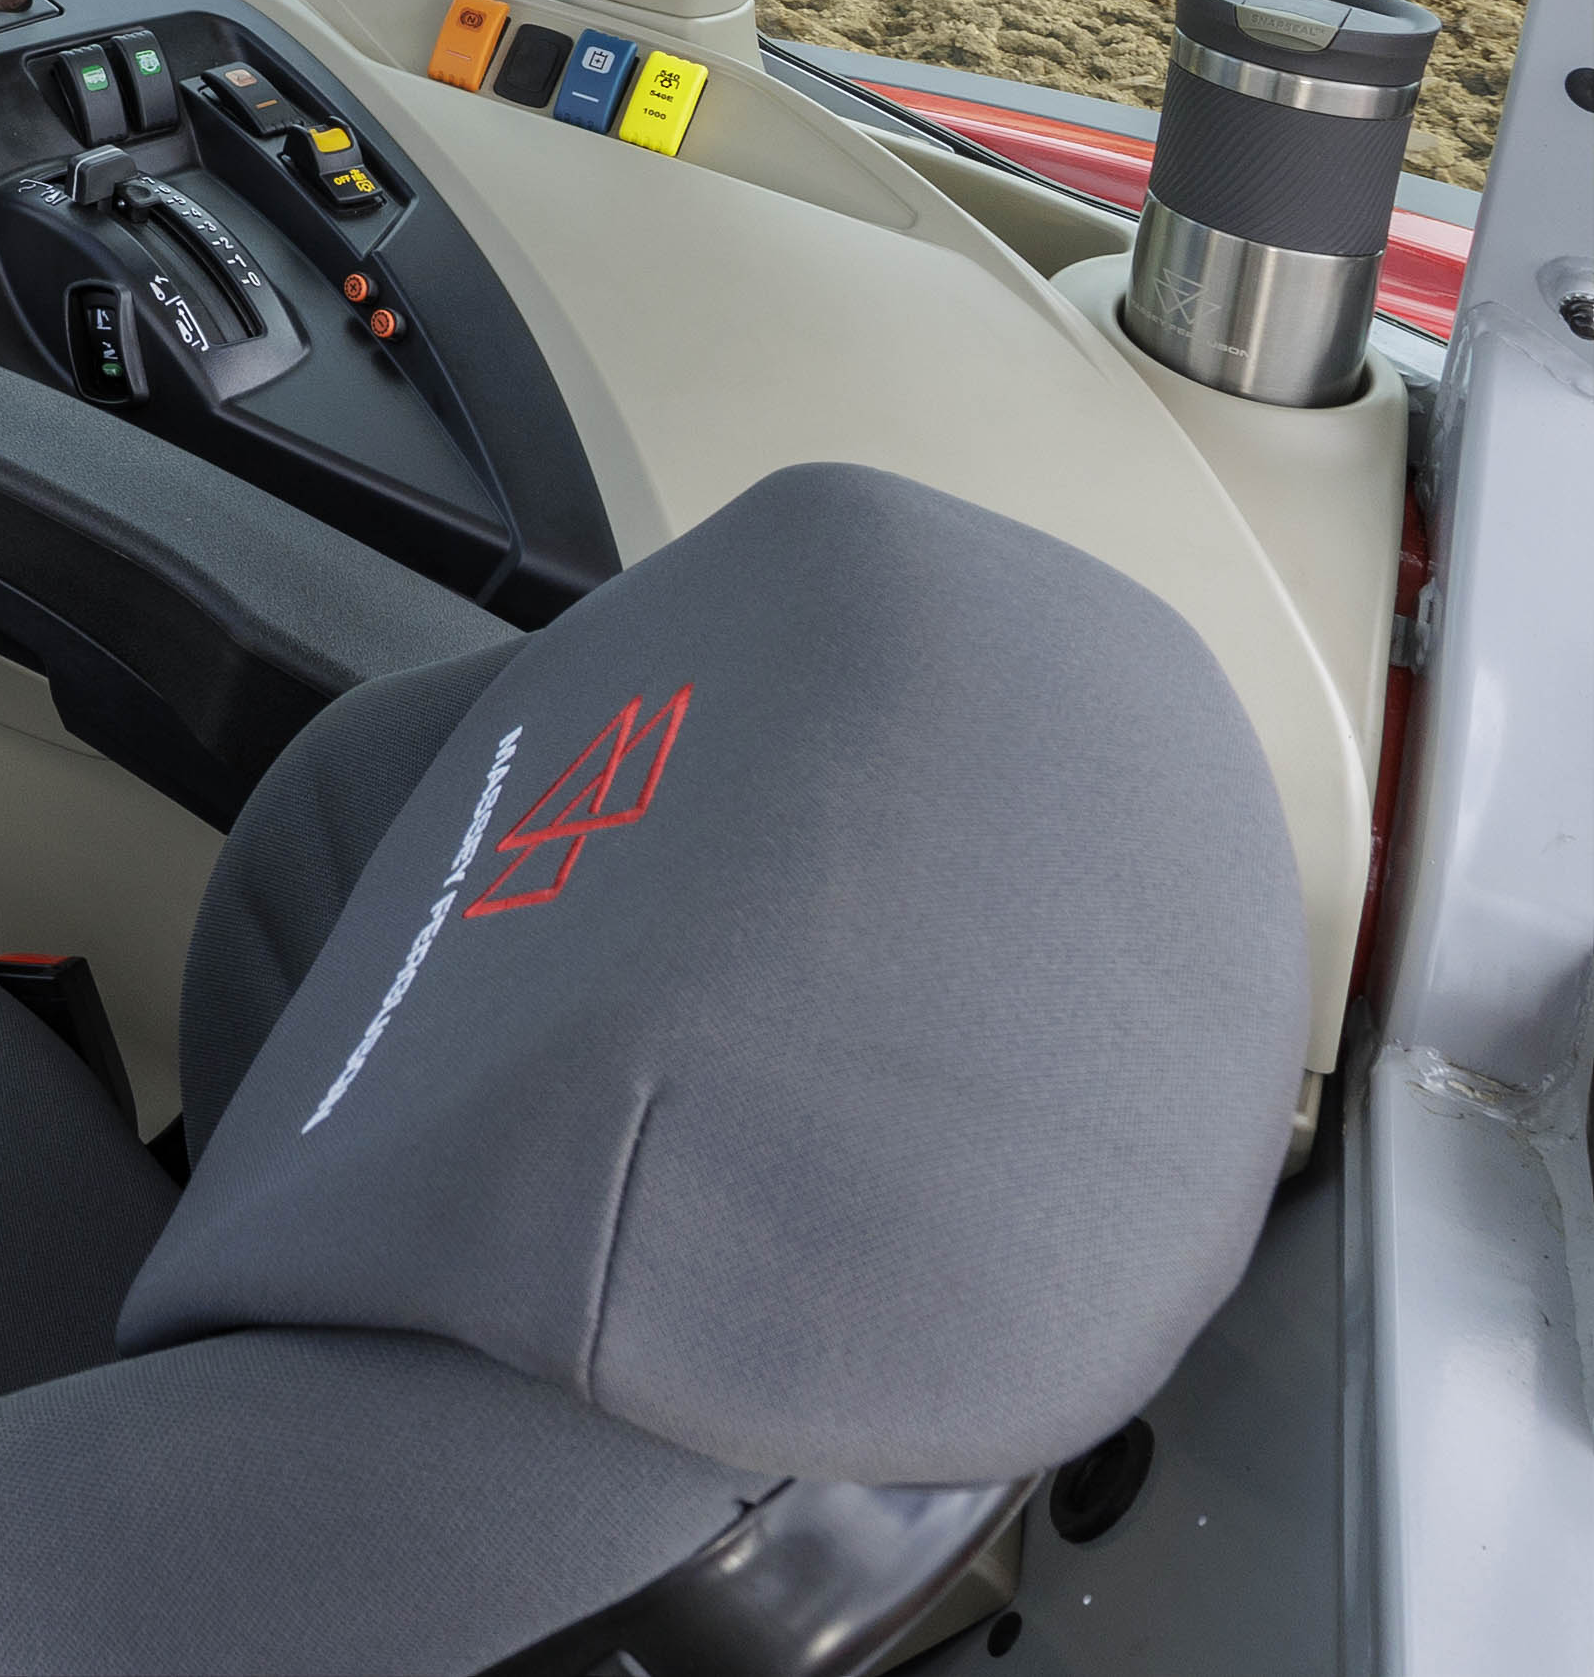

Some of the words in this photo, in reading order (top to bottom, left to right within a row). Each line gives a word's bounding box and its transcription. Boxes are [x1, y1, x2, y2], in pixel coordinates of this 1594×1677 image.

[660, 69, 680, 81] 540
[643, 107, 667, 120] 1000
[142, 176, 156, 184] 7
[333, 174, 351, 186] OFF
[158, 185, 171, 194] 6
[173, 195, 186, 205] 5
[191, 207, 202, 218] 4
[203, 220, 217, 232] 3
[219, 236, 234, 249] 2
[234, 253, 247, 268] 1
[247, 271, 261, 287] 0
[444, 725, 523, 888] MASSEY
[301, 889, 458, 1136] FERGUSON
